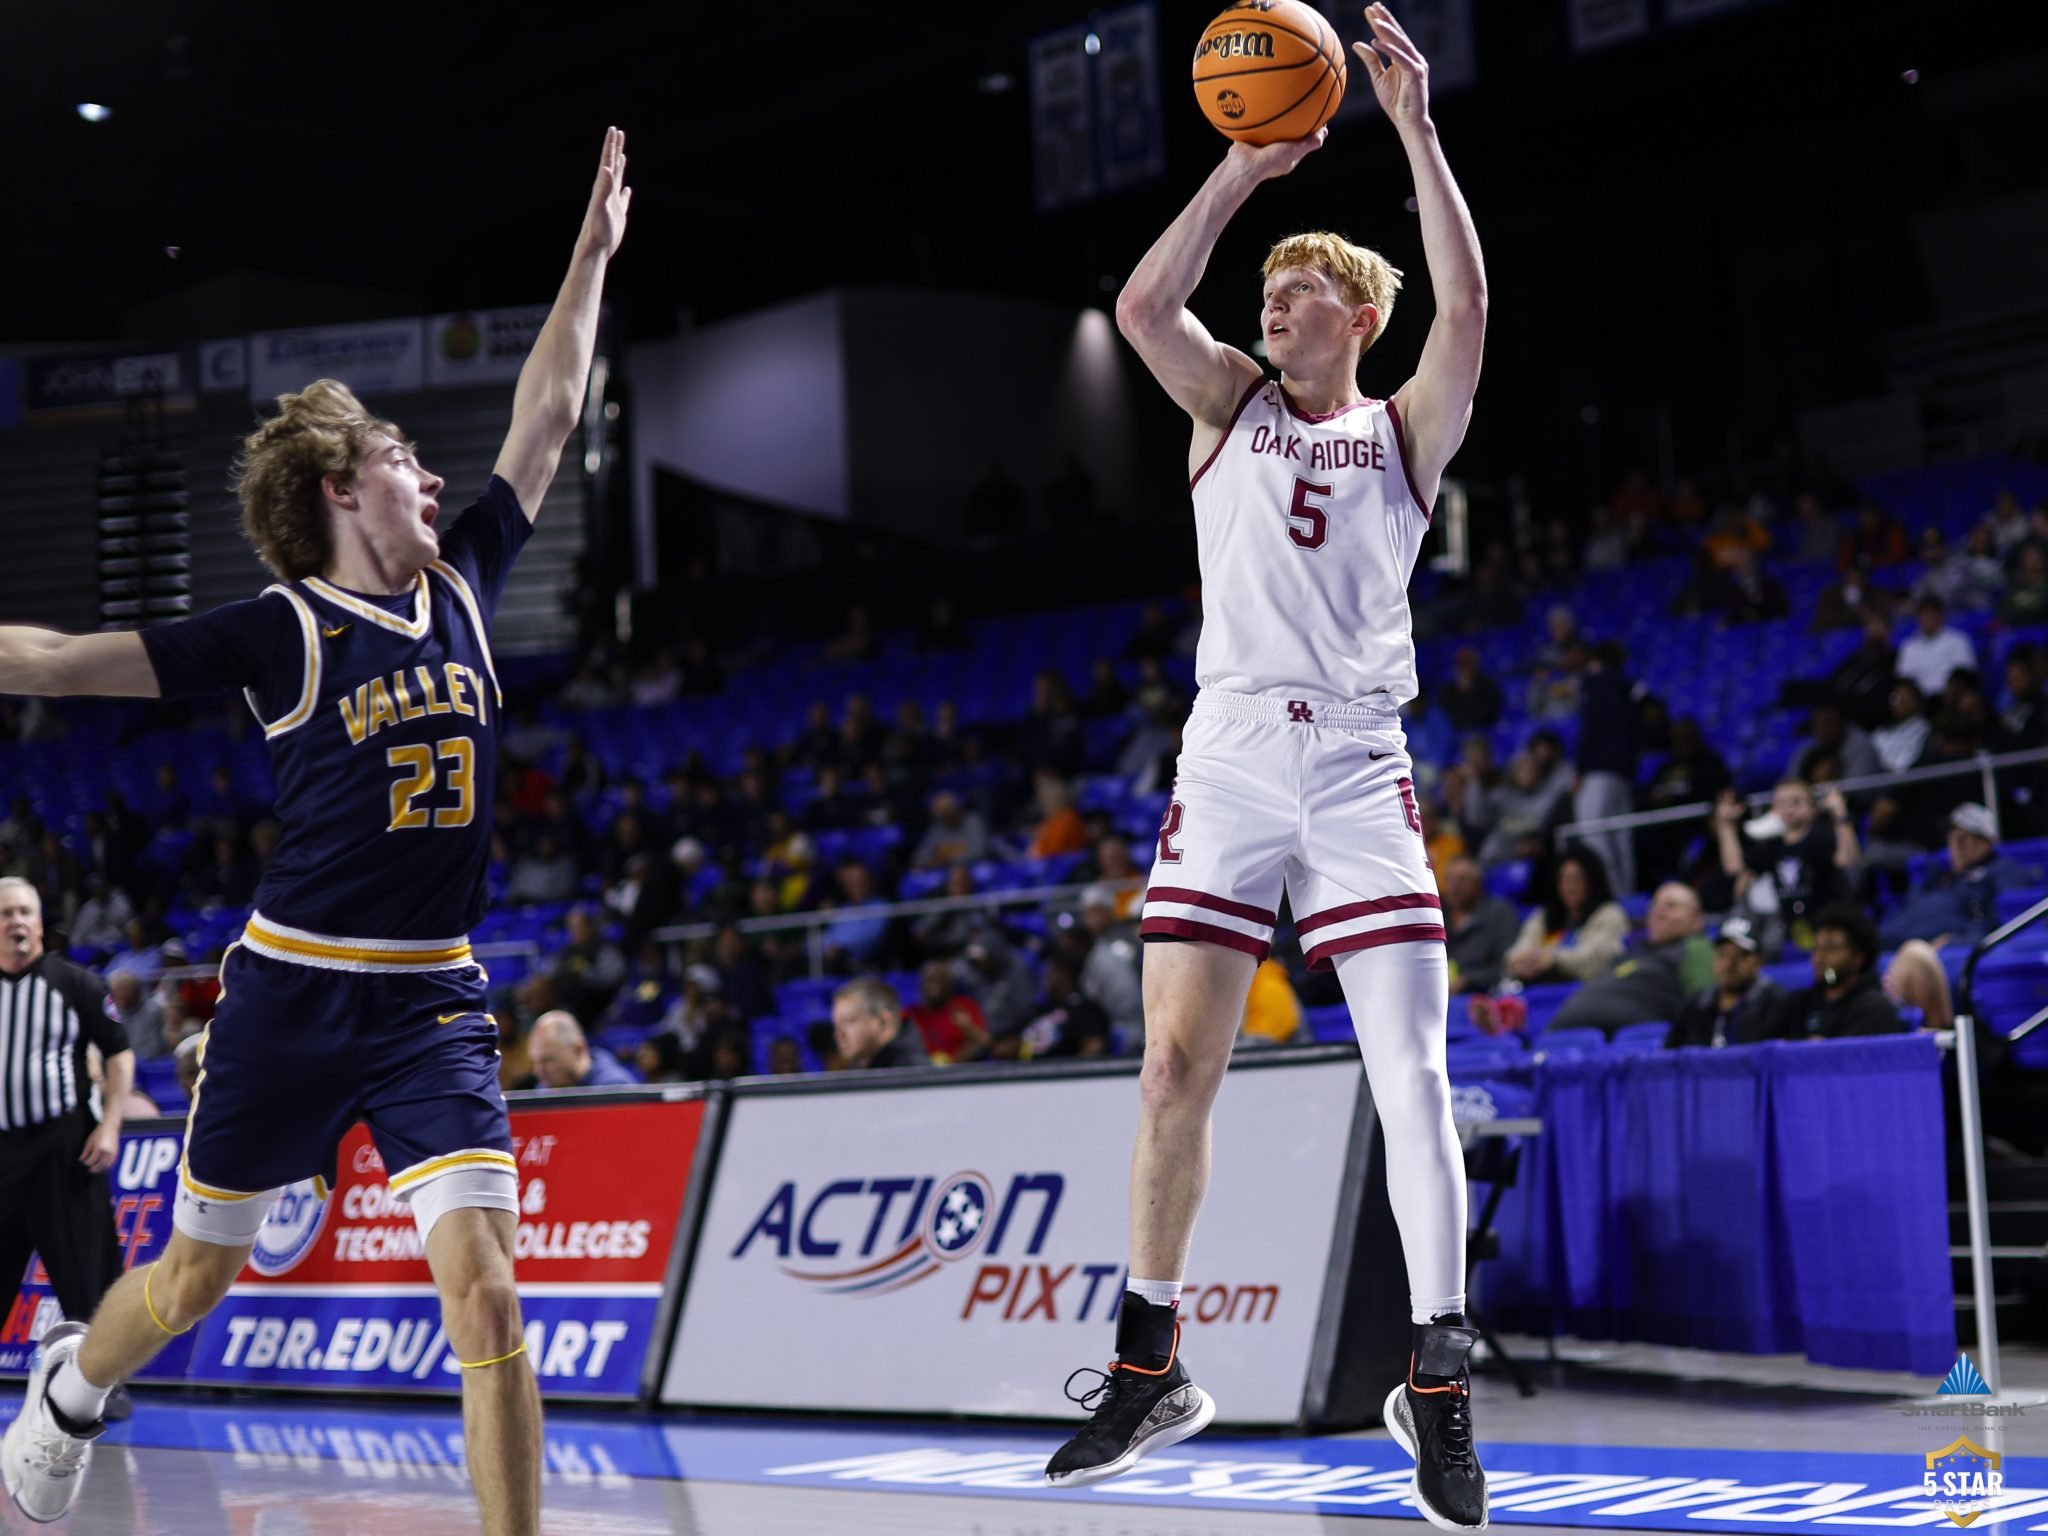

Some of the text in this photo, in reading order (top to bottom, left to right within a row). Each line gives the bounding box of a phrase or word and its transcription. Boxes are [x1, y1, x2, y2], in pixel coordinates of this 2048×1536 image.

[1195, 31, 1274, 61] Wilson
[1250, 425, 1387, 472] OAK RIDGE
[1286, 473, 1335, 553] 5
[338, 662, 487, 746] VALLEY
[386, 735, 476, 833] 23
[118, 1136, 179, 1191] UP
[519, 1134, 558, 1167] AT
[520, 1177, 547, 1216] &
[513, 1219, 653, 1261] OLLEGES
